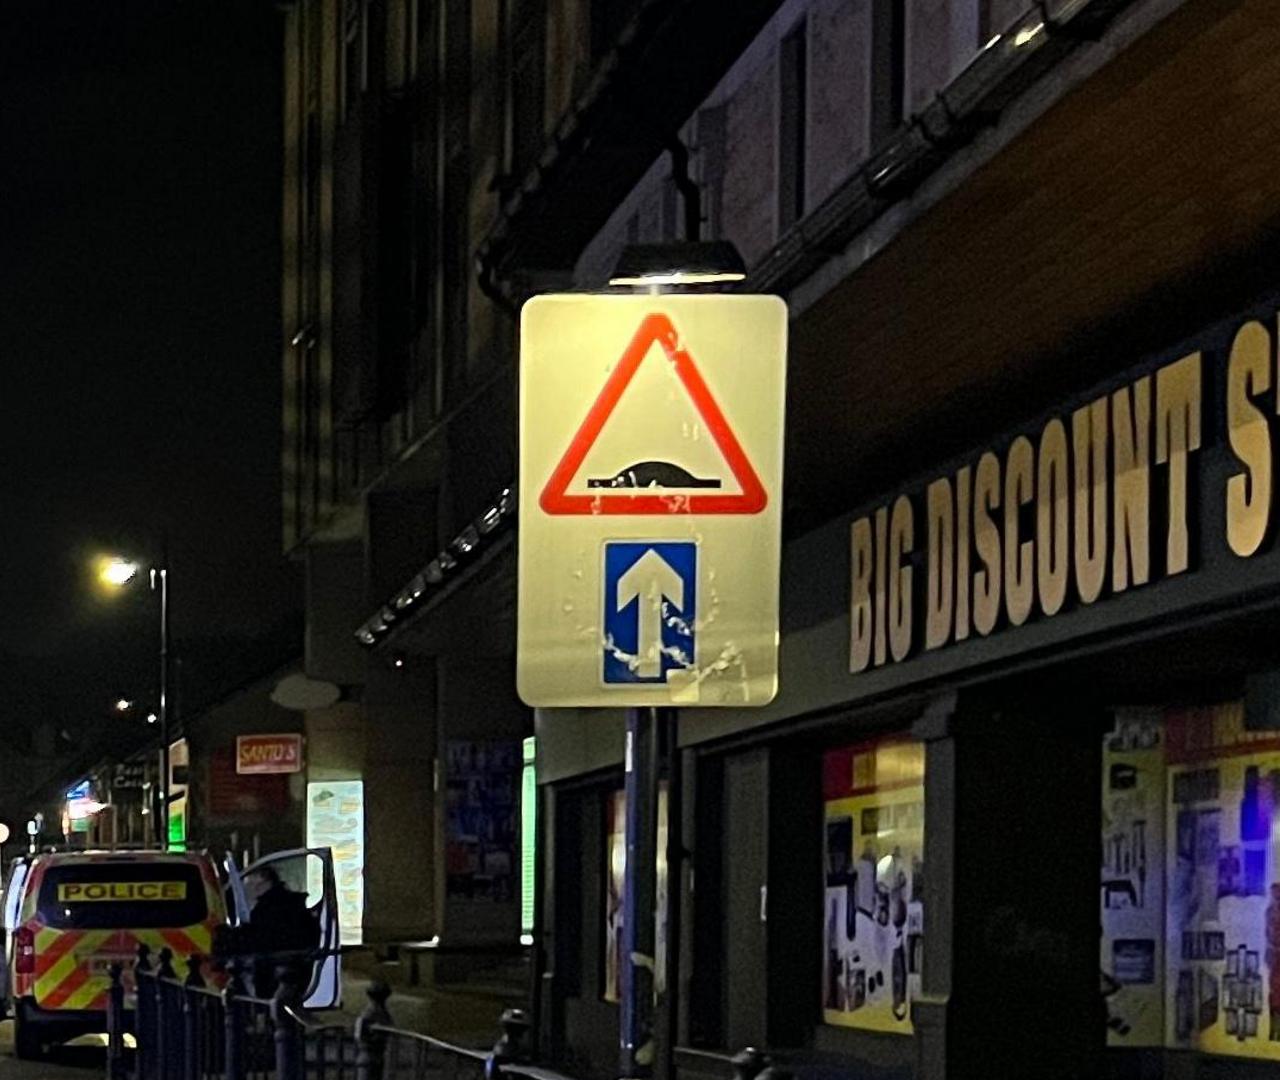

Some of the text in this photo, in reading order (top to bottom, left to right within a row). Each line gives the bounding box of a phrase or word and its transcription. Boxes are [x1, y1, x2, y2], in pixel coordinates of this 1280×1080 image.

[850, 311, 1280, 674] BIG DISCOUNT S
[63, 884, 177, 899] POLICE
